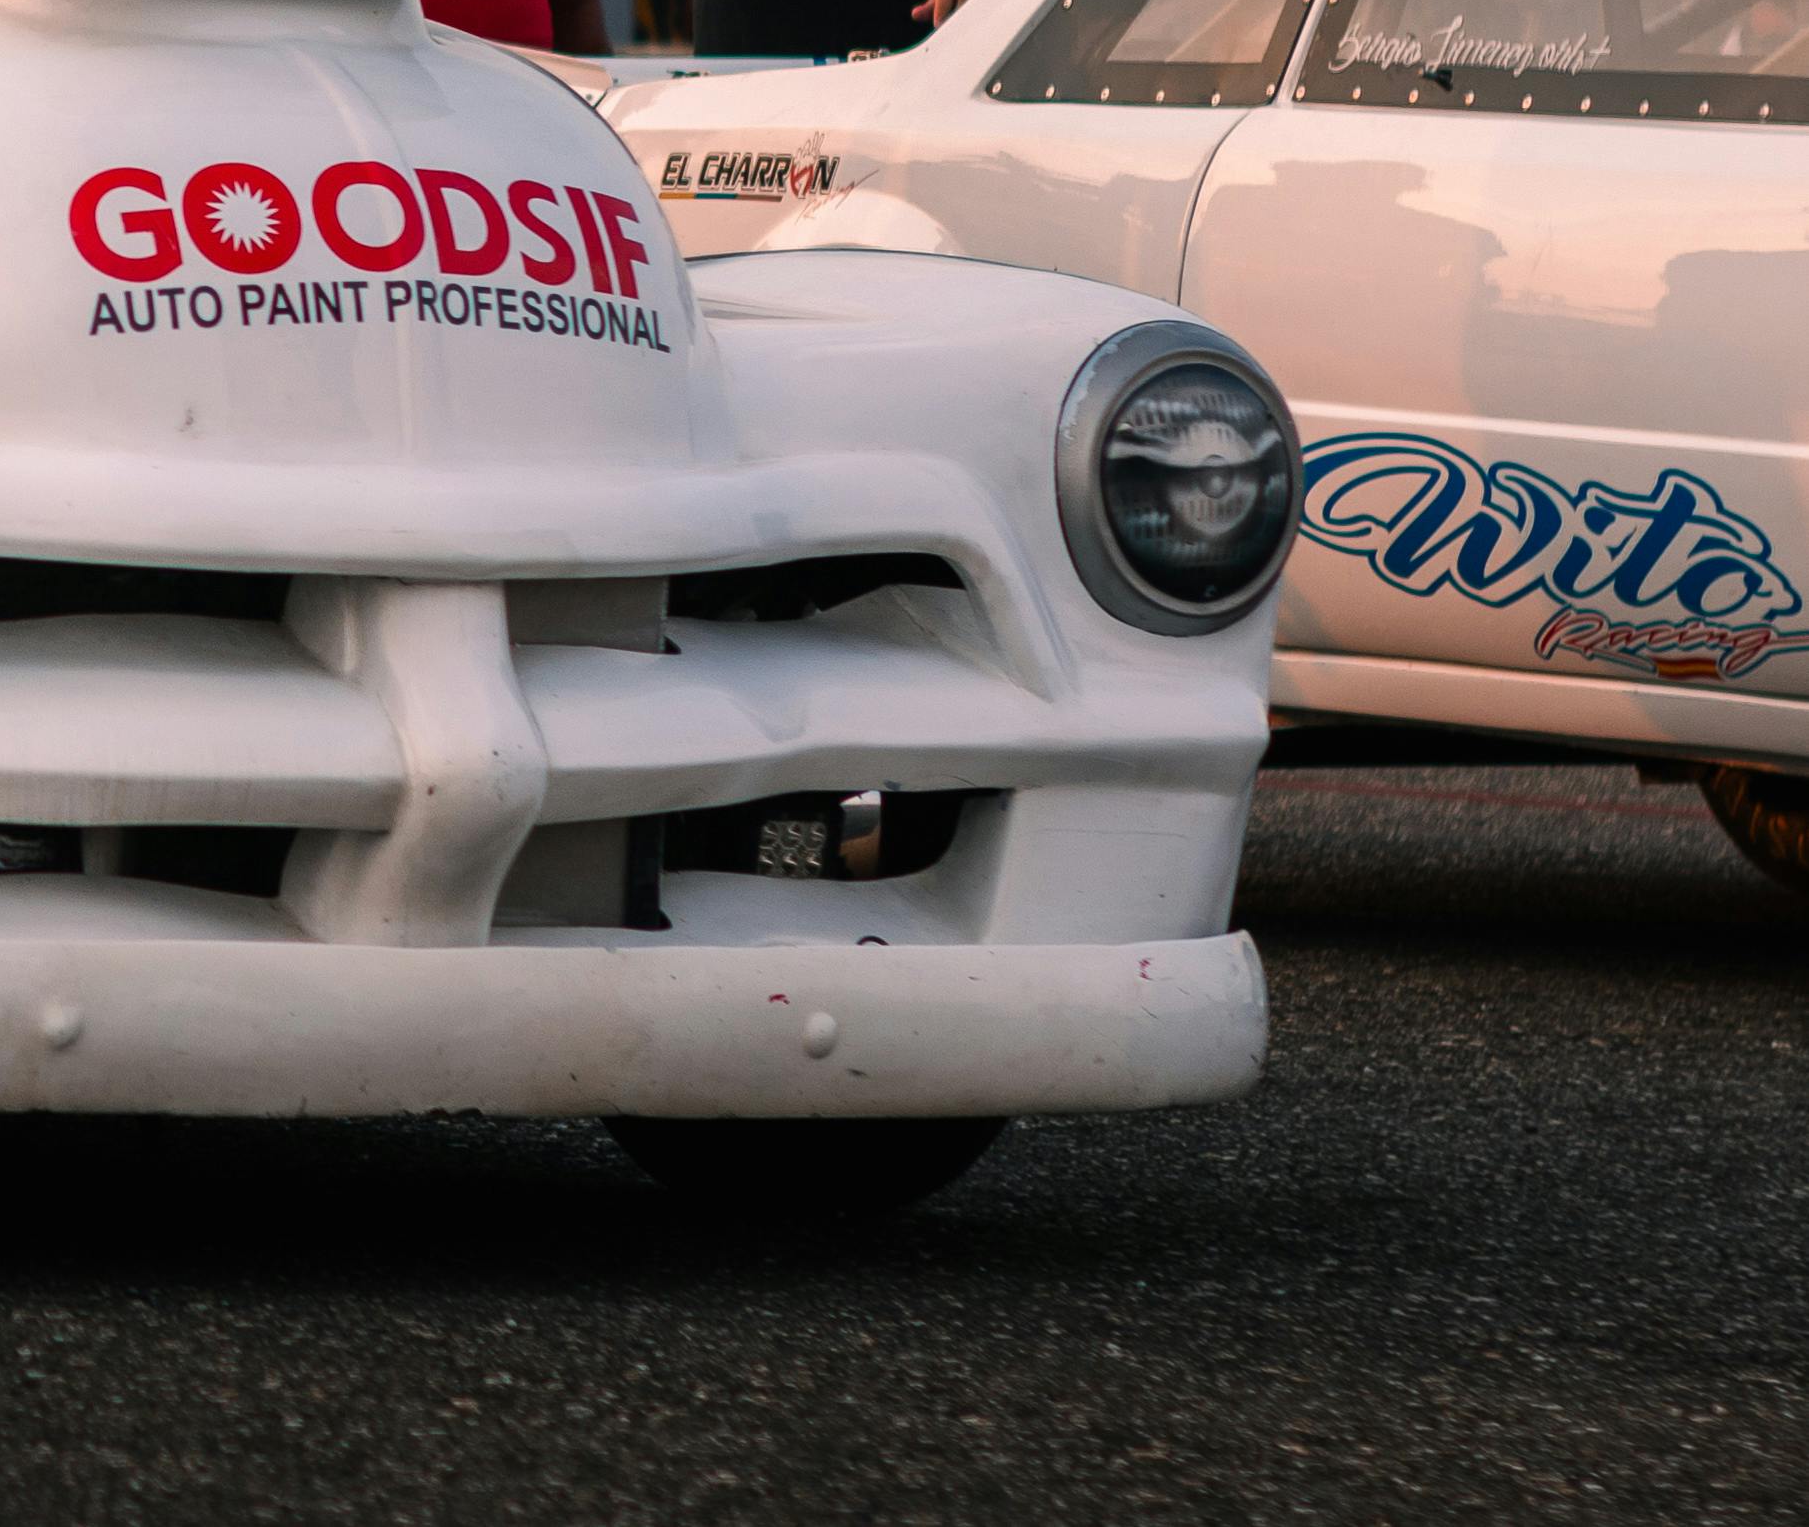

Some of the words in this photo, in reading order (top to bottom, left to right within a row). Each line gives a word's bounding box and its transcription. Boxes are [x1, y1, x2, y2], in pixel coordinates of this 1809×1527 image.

[660, 152, 691, 190] EL
[68, 160, 650, 300] GOODSIF
[89, 284, 223, 336] AUTO
[238, 280, 369, 326] PAINT
[387, 279, 672, 353] PROFESSIONAL
[1300, 431, 1803, 620] Wito
[1534, 603, 1784, 678] Racing
